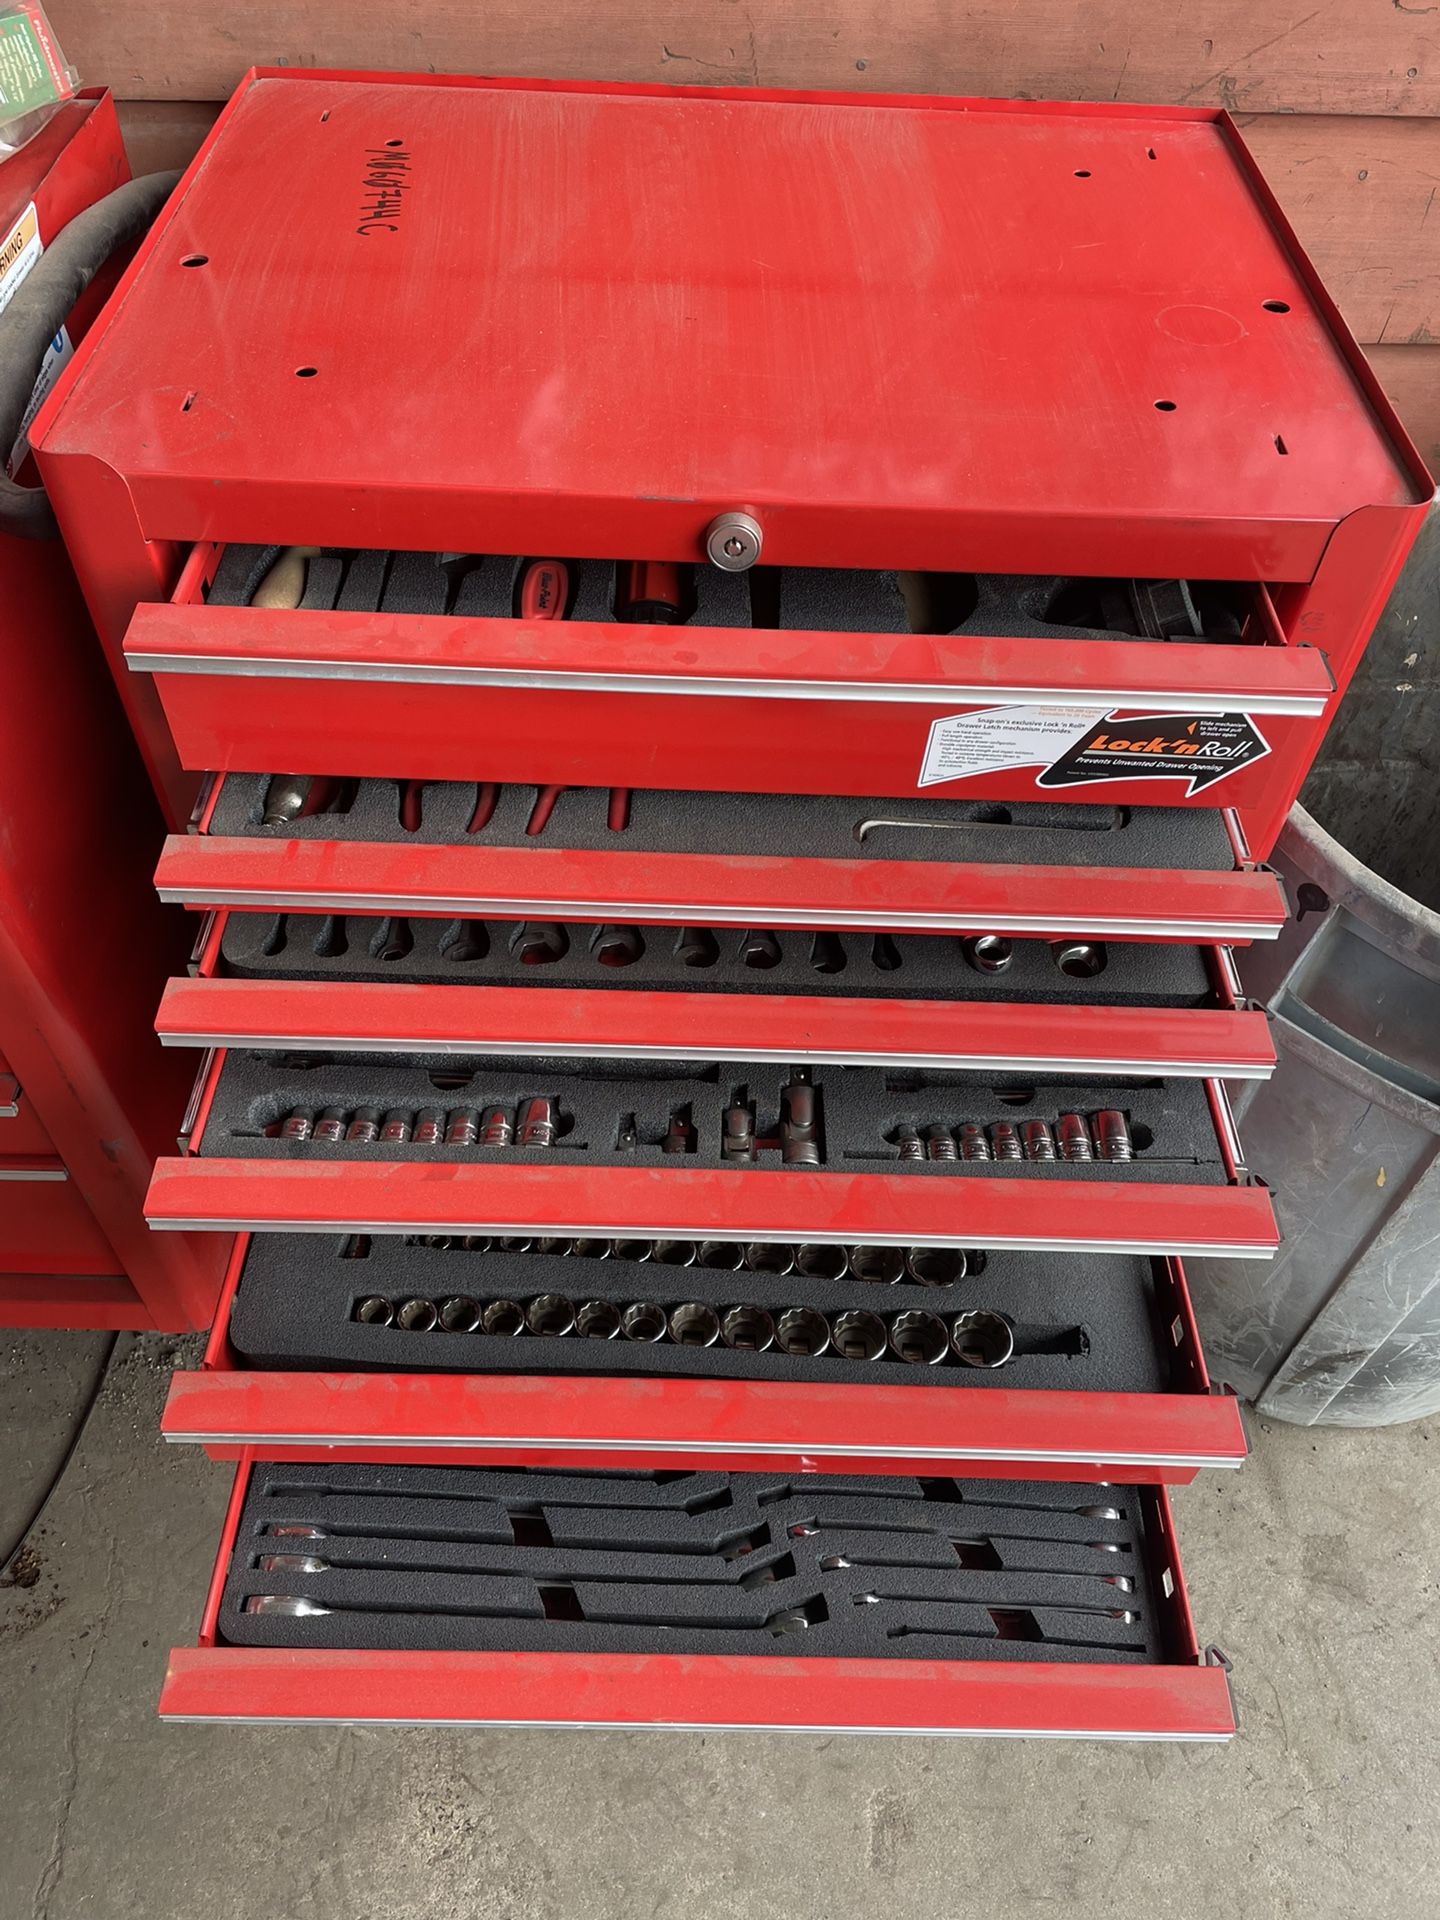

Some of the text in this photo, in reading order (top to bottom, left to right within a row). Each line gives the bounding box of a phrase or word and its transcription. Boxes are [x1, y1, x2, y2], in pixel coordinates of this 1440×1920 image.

[978, 717, 1010, 725] Snap-on's
[1002, 725, 1040, 733] mechanism
[1075, 757, 1224, 773] Prevents Unwanted Drawer Opening
